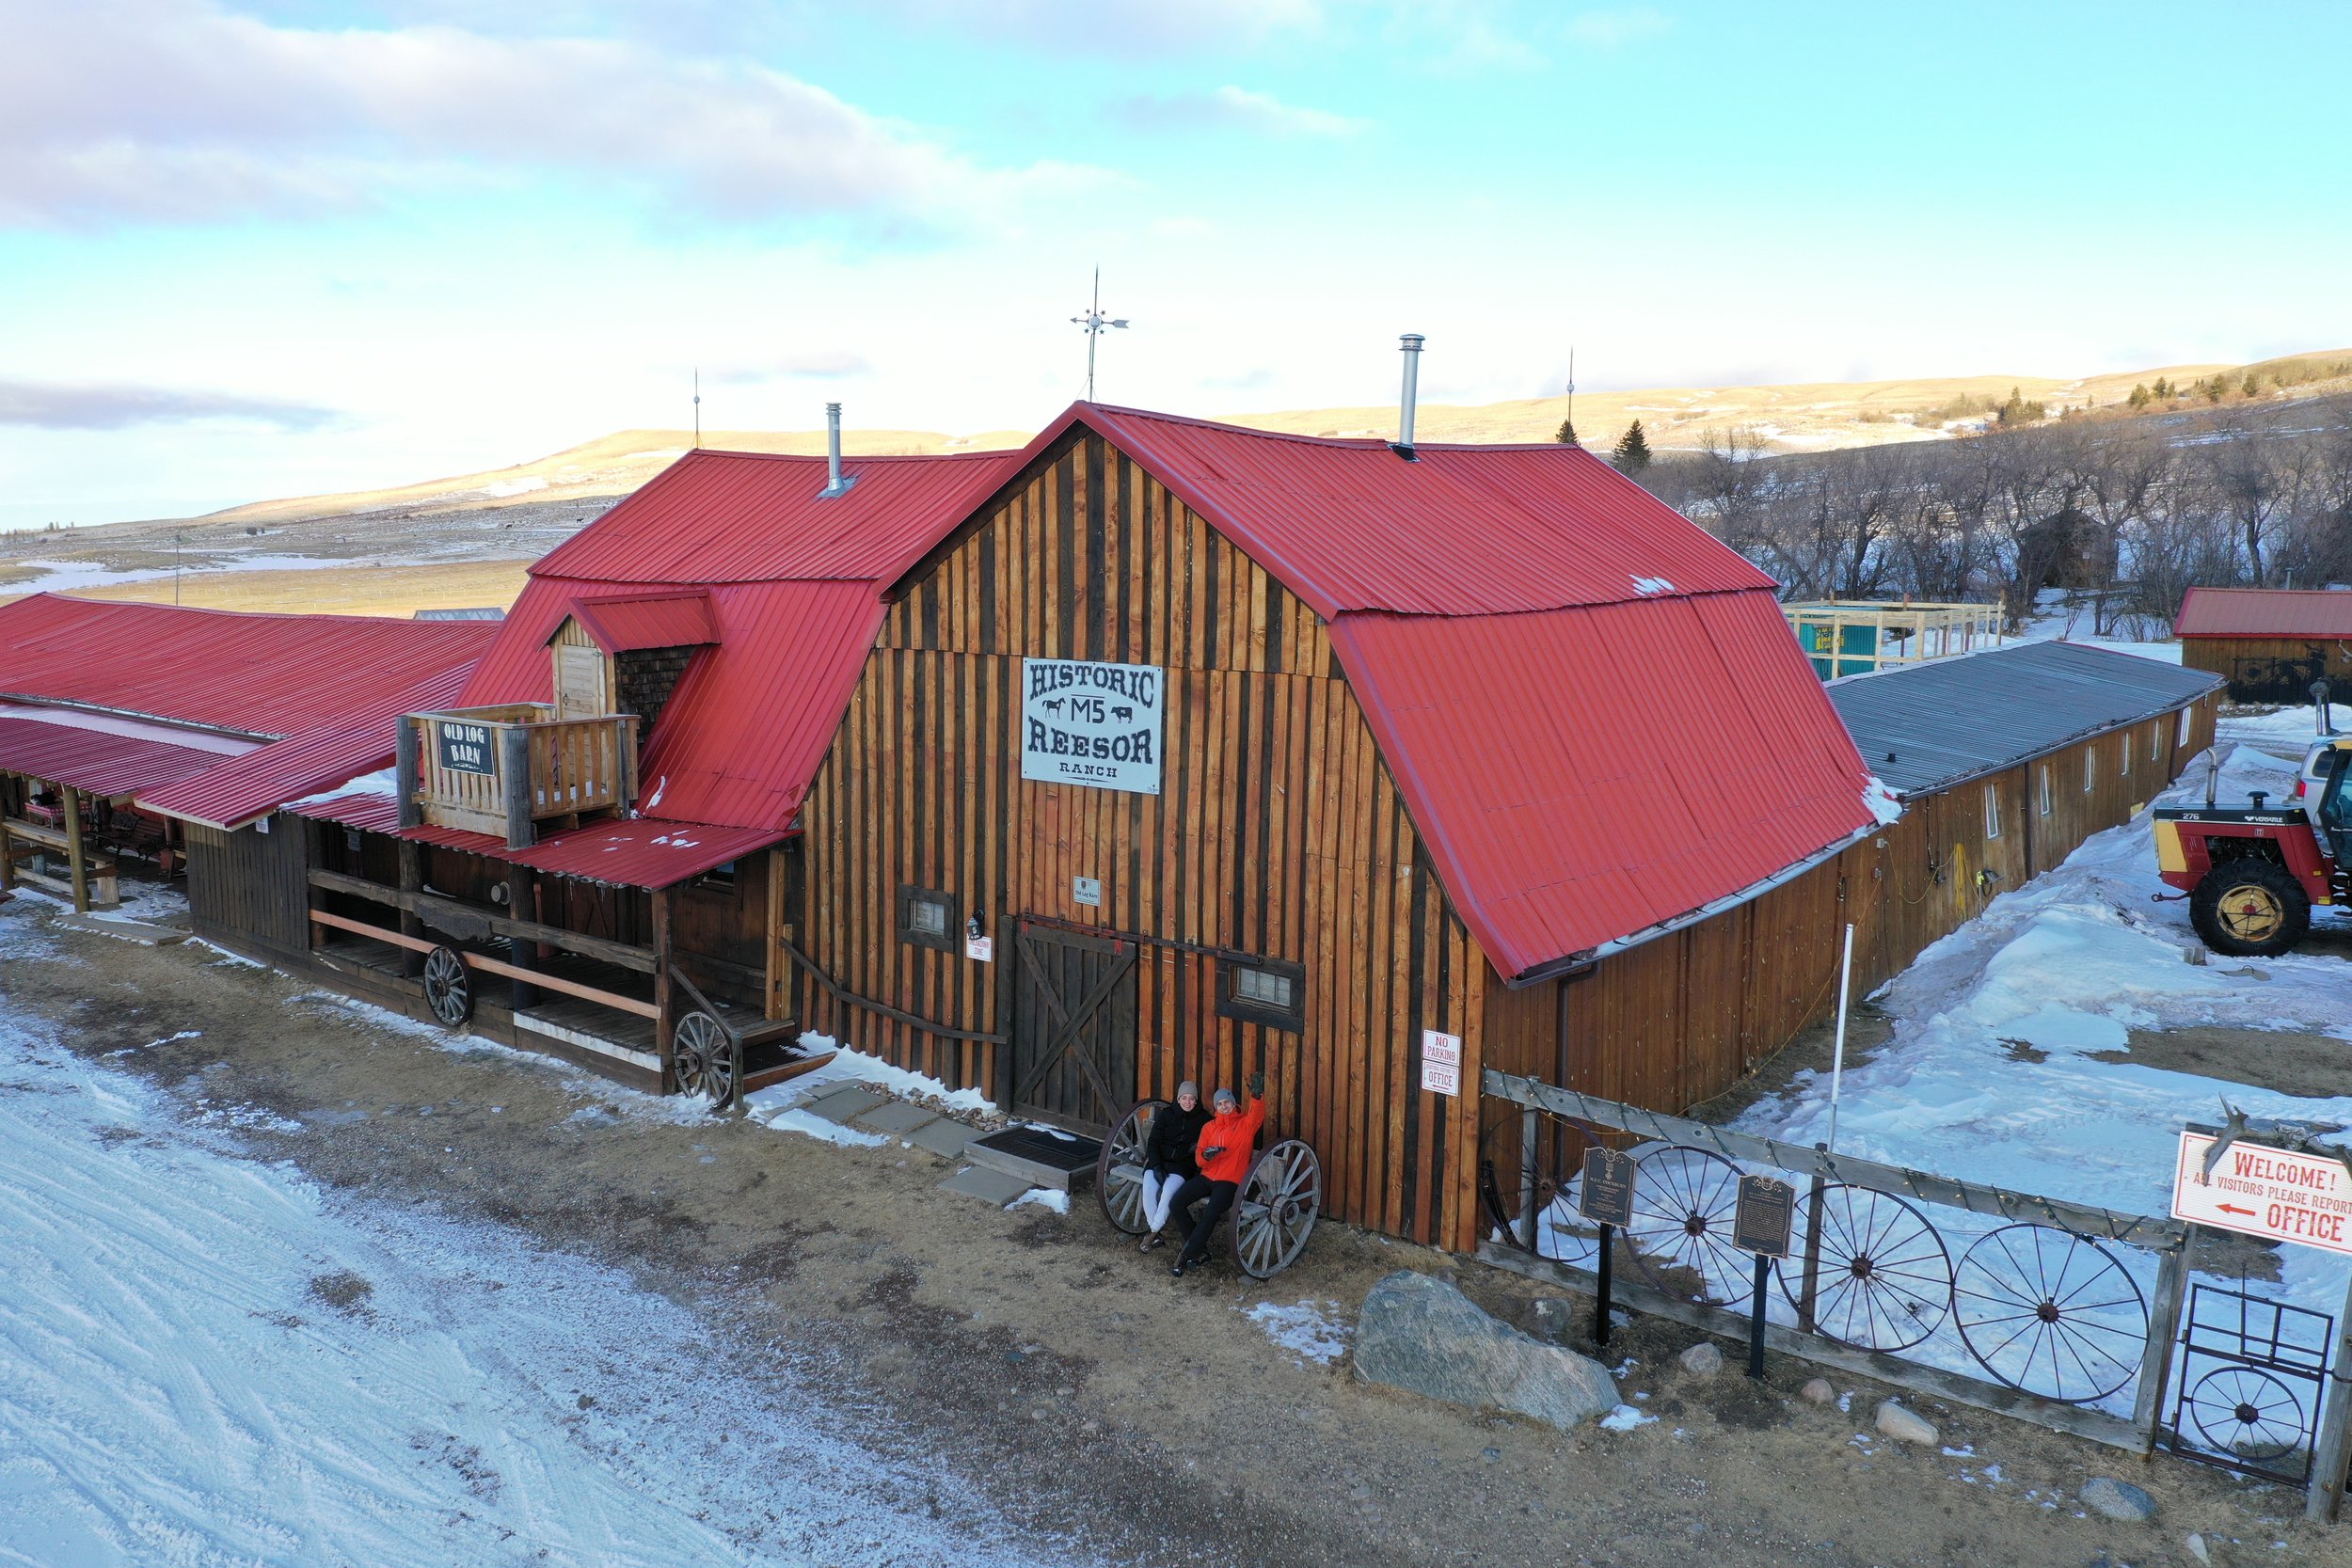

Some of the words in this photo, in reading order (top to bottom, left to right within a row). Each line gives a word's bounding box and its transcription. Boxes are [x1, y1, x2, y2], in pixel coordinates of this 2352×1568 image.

[1029, 664, 1154, 708] HISTORIC
[1071, 697, 1105, 723] M5
[444, 723, 463, 741] OLD
[466, 726, 485, 744] LOG
[1028, 715, 1152, 764] REESOR
[451, 744, 481, 765] BARN
[1059, 762, 1118, 778] RANCH
[1436, 1036, 1448, 1047] NO
[1427, 1046, 1454, 1061] PARKING
[1428, 1071, 1453, 1086] OFFICE
[2234, 1151, 2336, 1192] WELCOME!
[2217, 1176, 2265, 1196] VISITORS
[2267, 1186, 2308, 1205] PLEASE
[2312, 1195, 2352, 1214] REPORT
[2266, 1203, 2345, 1243] OFFICE
